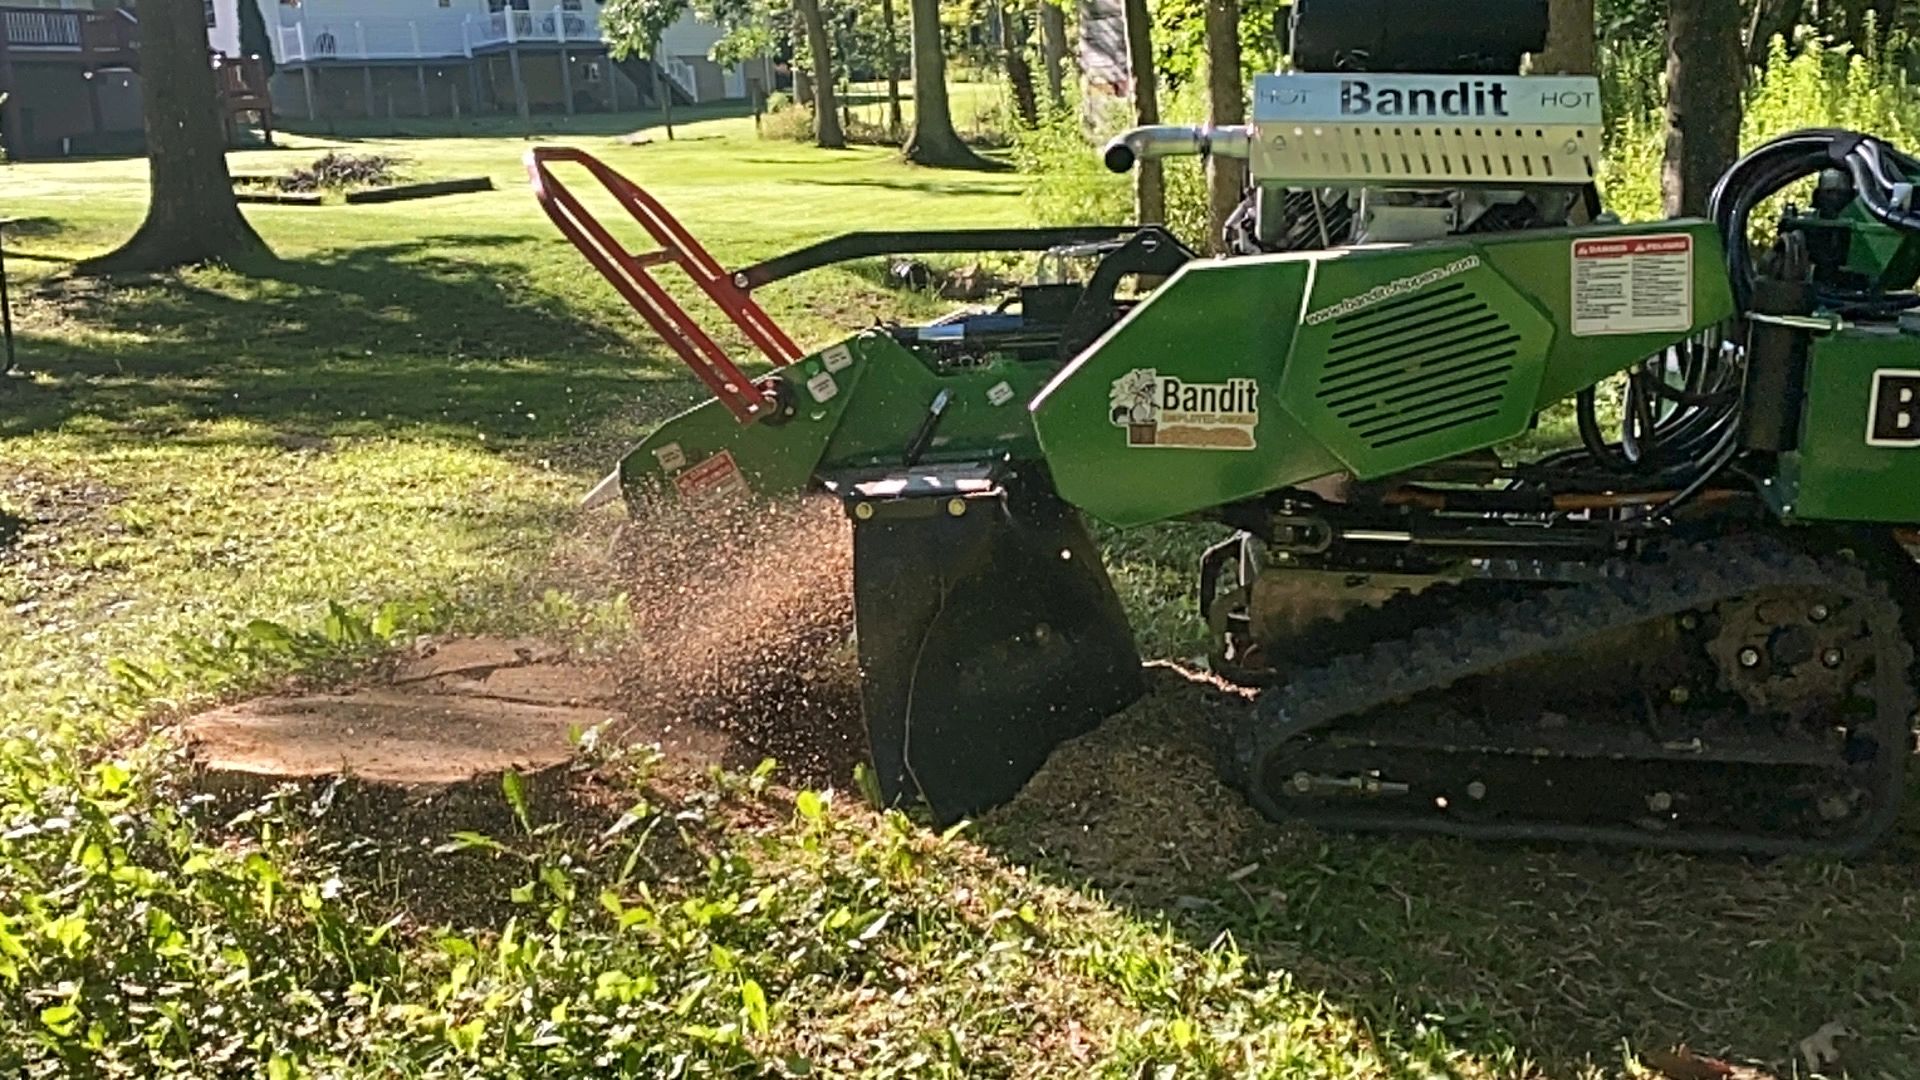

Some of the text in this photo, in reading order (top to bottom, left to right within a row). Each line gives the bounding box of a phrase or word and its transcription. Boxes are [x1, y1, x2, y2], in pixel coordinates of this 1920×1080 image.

[1341, 80, 1509, 117] Bandit
[1541, 92, 1595, 108] HOT
[1163, 379, 1256, 413] Bandit
